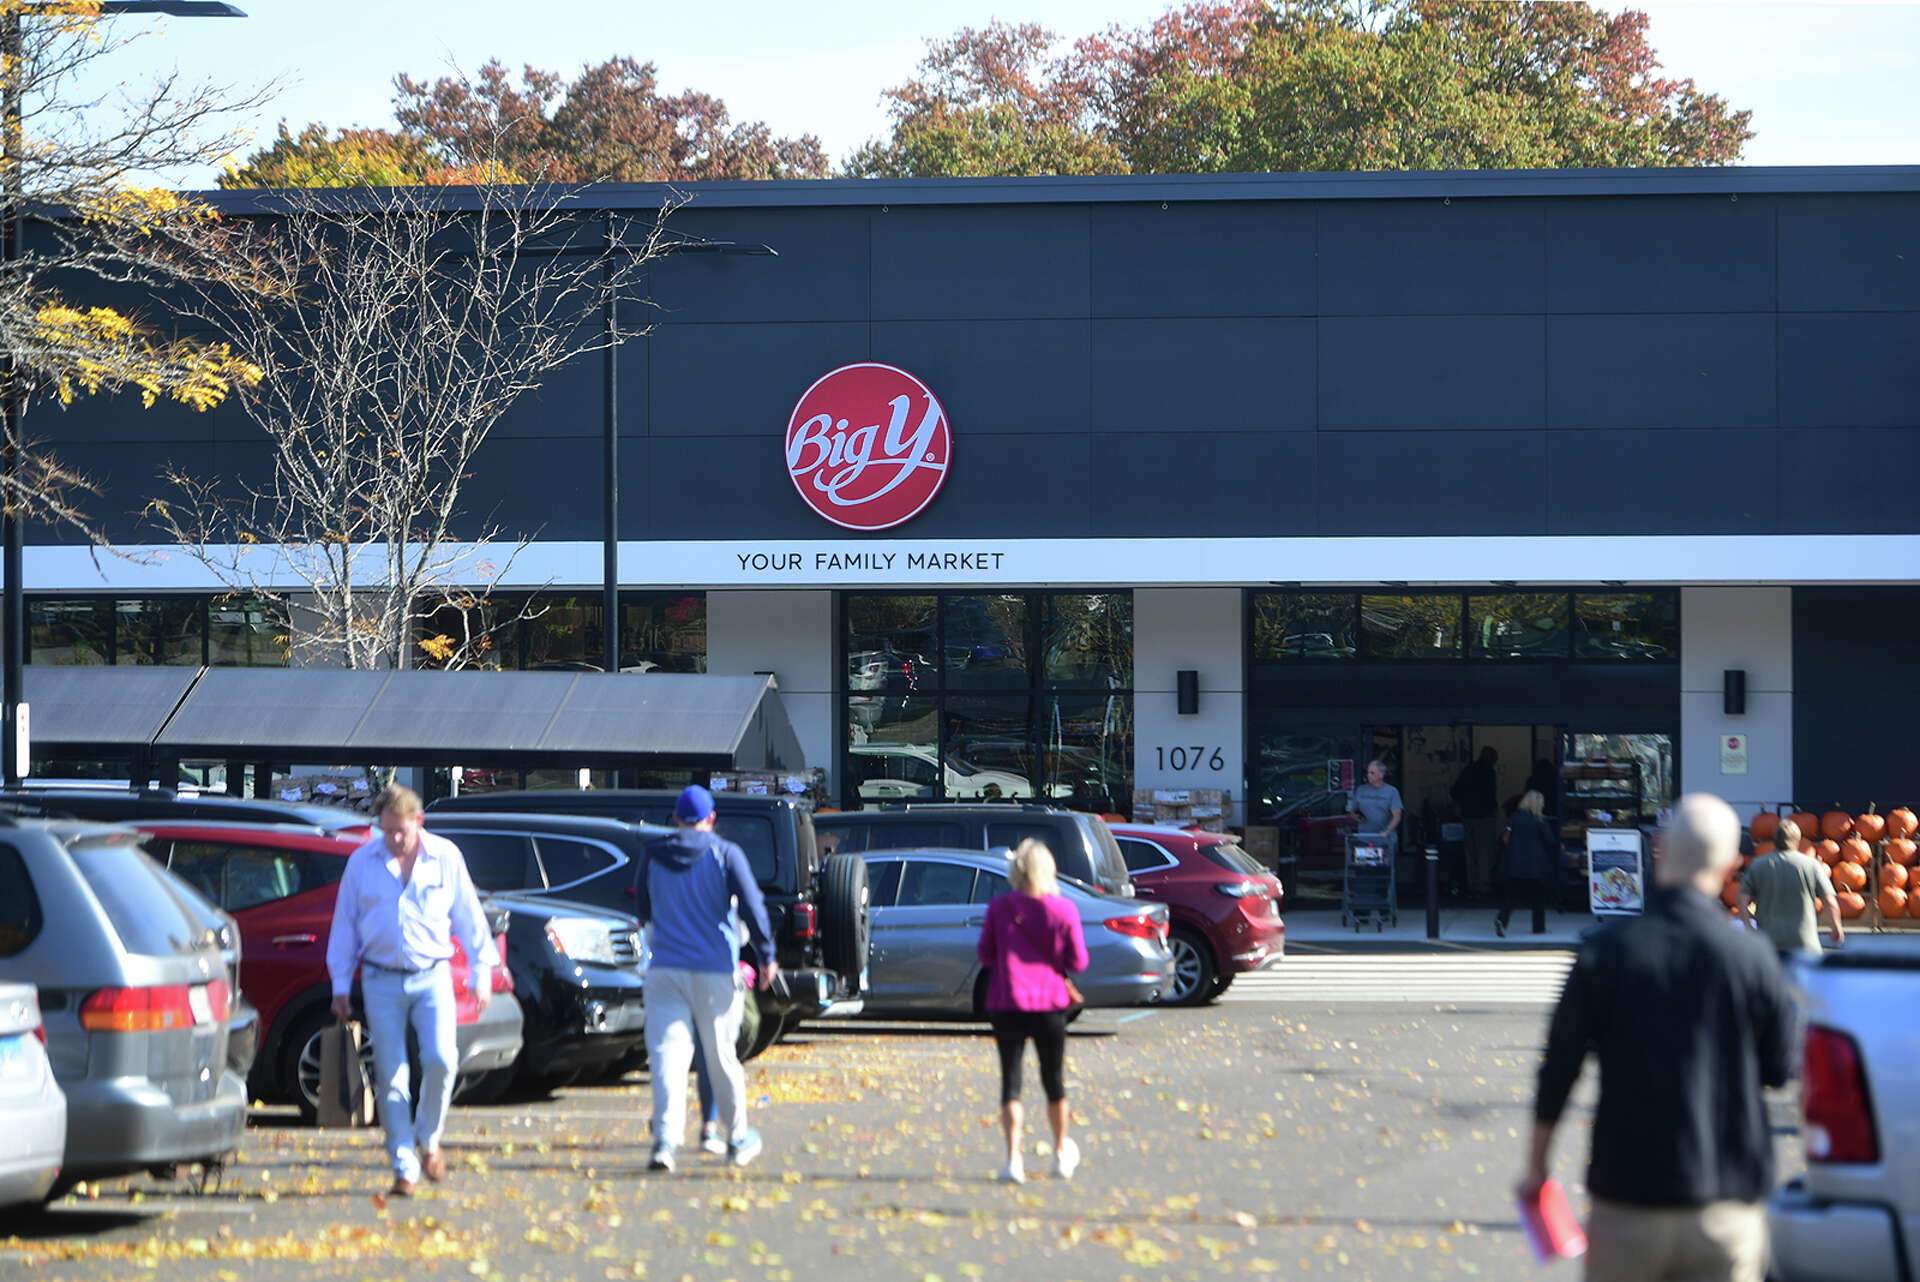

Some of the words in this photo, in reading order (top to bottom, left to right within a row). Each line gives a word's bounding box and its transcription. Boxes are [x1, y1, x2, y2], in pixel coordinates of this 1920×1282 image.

[787, 414, 880, 492] Big
[737, 552, 802, 571] YOUR
[815, 552, 896, 571] FAMILY
[907, 552, 1005, 571] MARKET
[1156, 746, 1225, 772] 1076
